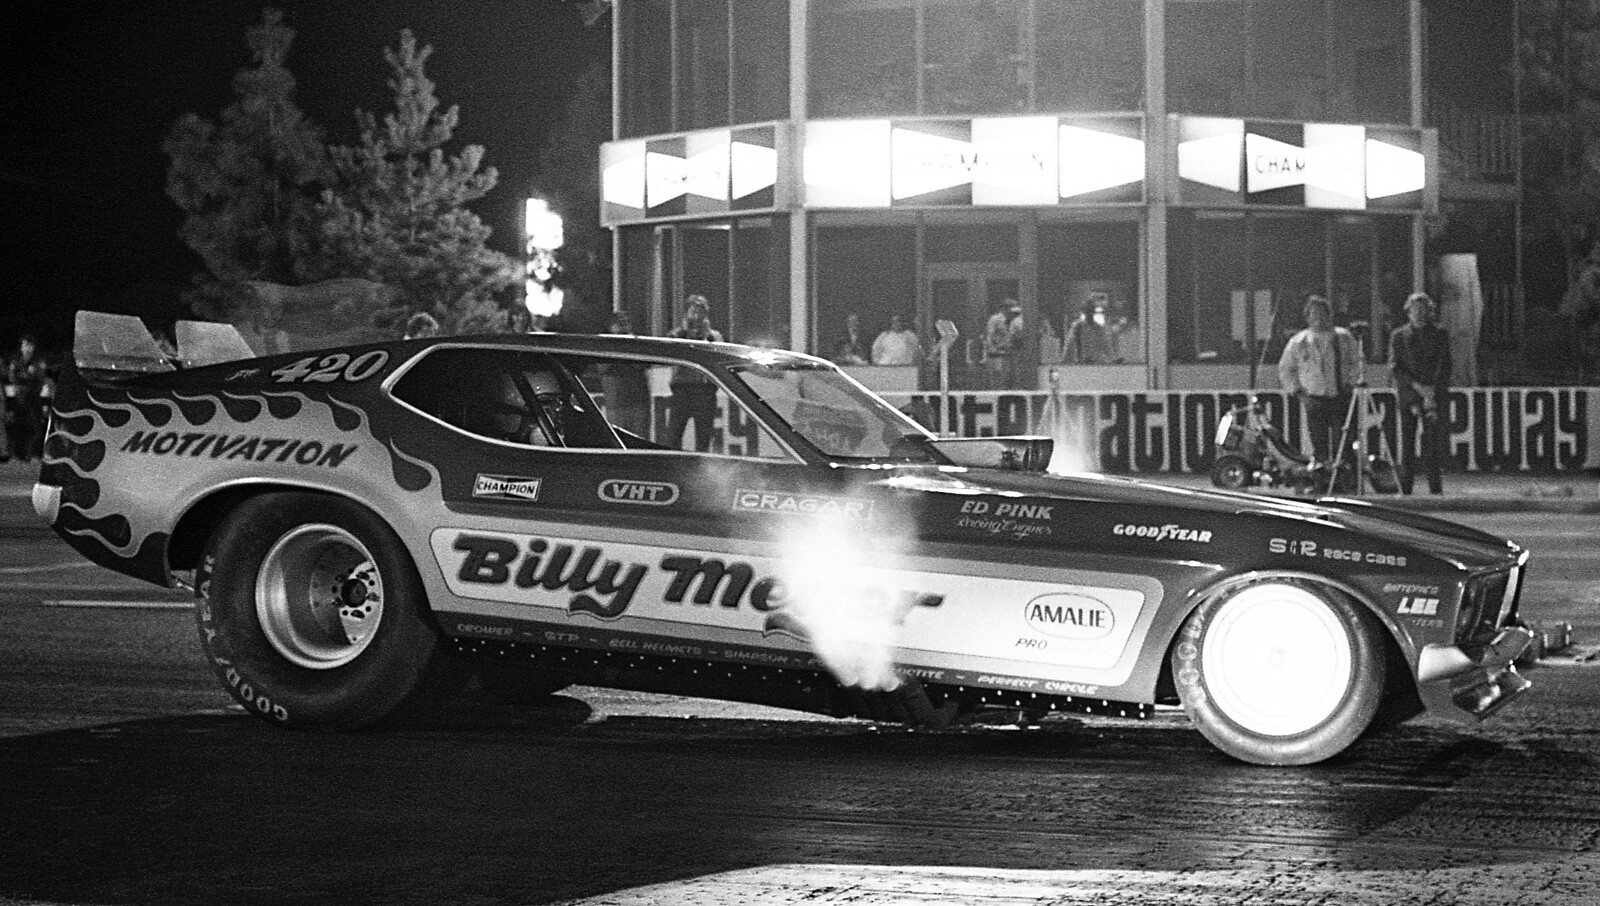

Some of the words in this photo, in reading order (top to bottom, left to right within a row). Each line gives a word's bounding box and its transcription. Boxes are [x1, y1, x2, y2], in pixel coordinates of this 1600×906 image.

[271, 350, 389, 383] 420
[121, 431, 358, 468] MOTIVATION
[476, 478, 536, 496] CHAMPION
[611, 482, 665, 502] VHT
[741, 493, 864, 519] CRAGAR
[960, 500, 989, 514] ED
[995, 503, 1054, 520] PINK
[955, 515, 1001, 536] Racing
[999, 518, 1052, 540] Engines
[1112, 523, 1213, 543] GOODYEAR
[451, 531, 649, 618] Billy
[1029, 603, 1106, 629] AMALIE
[1396, 596, 1440, 616] LEE
[1014, 637, 1049, 650] PRO
[893, 666, 945, 680] OCTITE
